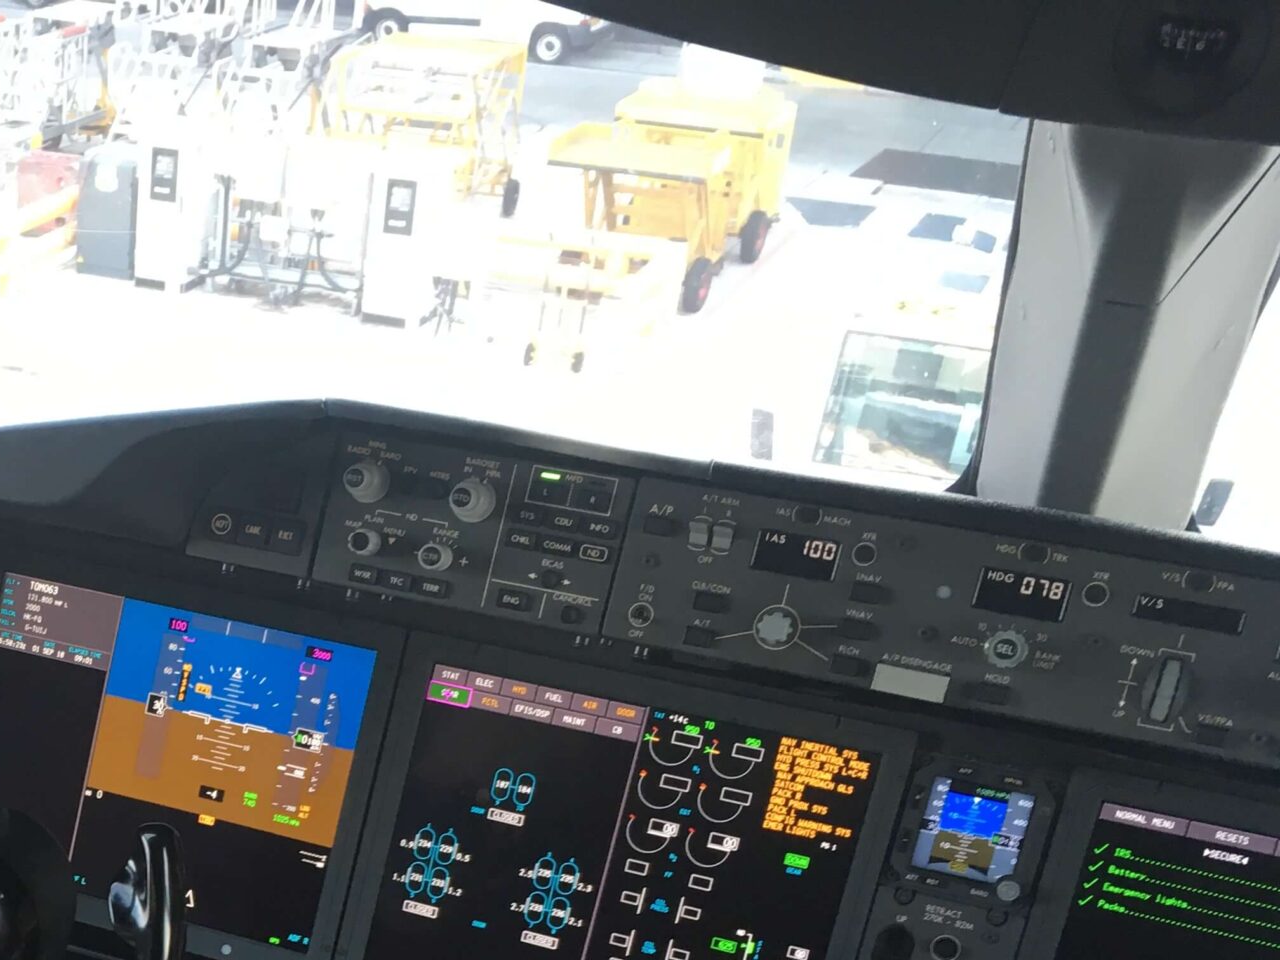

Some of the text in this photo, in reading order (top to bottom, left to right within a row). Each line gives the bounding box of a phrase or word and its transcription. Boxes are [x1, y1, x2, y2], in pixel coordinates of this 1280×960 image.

[648, 503, 675, 517] A/P
[765, 533, 837, 561] IAS 100
[987, 569, 1065, 600] HDG 078
[170, 618, 188, 631] 100
[441, 670, 461, 681] STAT
[474, 677, 495, 689] ELEC
[544, 692, 564, 703] FUEL
[582, 699, 599, 710] AIR
[562, 713, 587, 727] MAINT
[1114, 808, 1176, 830] NORMAL MENU
[1214, 830, 1251, 846] RESETS
[1209, 850, 1244, 865] SECURE
[1107, 864, 1147, 881] Battery
[1102, 881, 1152, 901] Emergency
